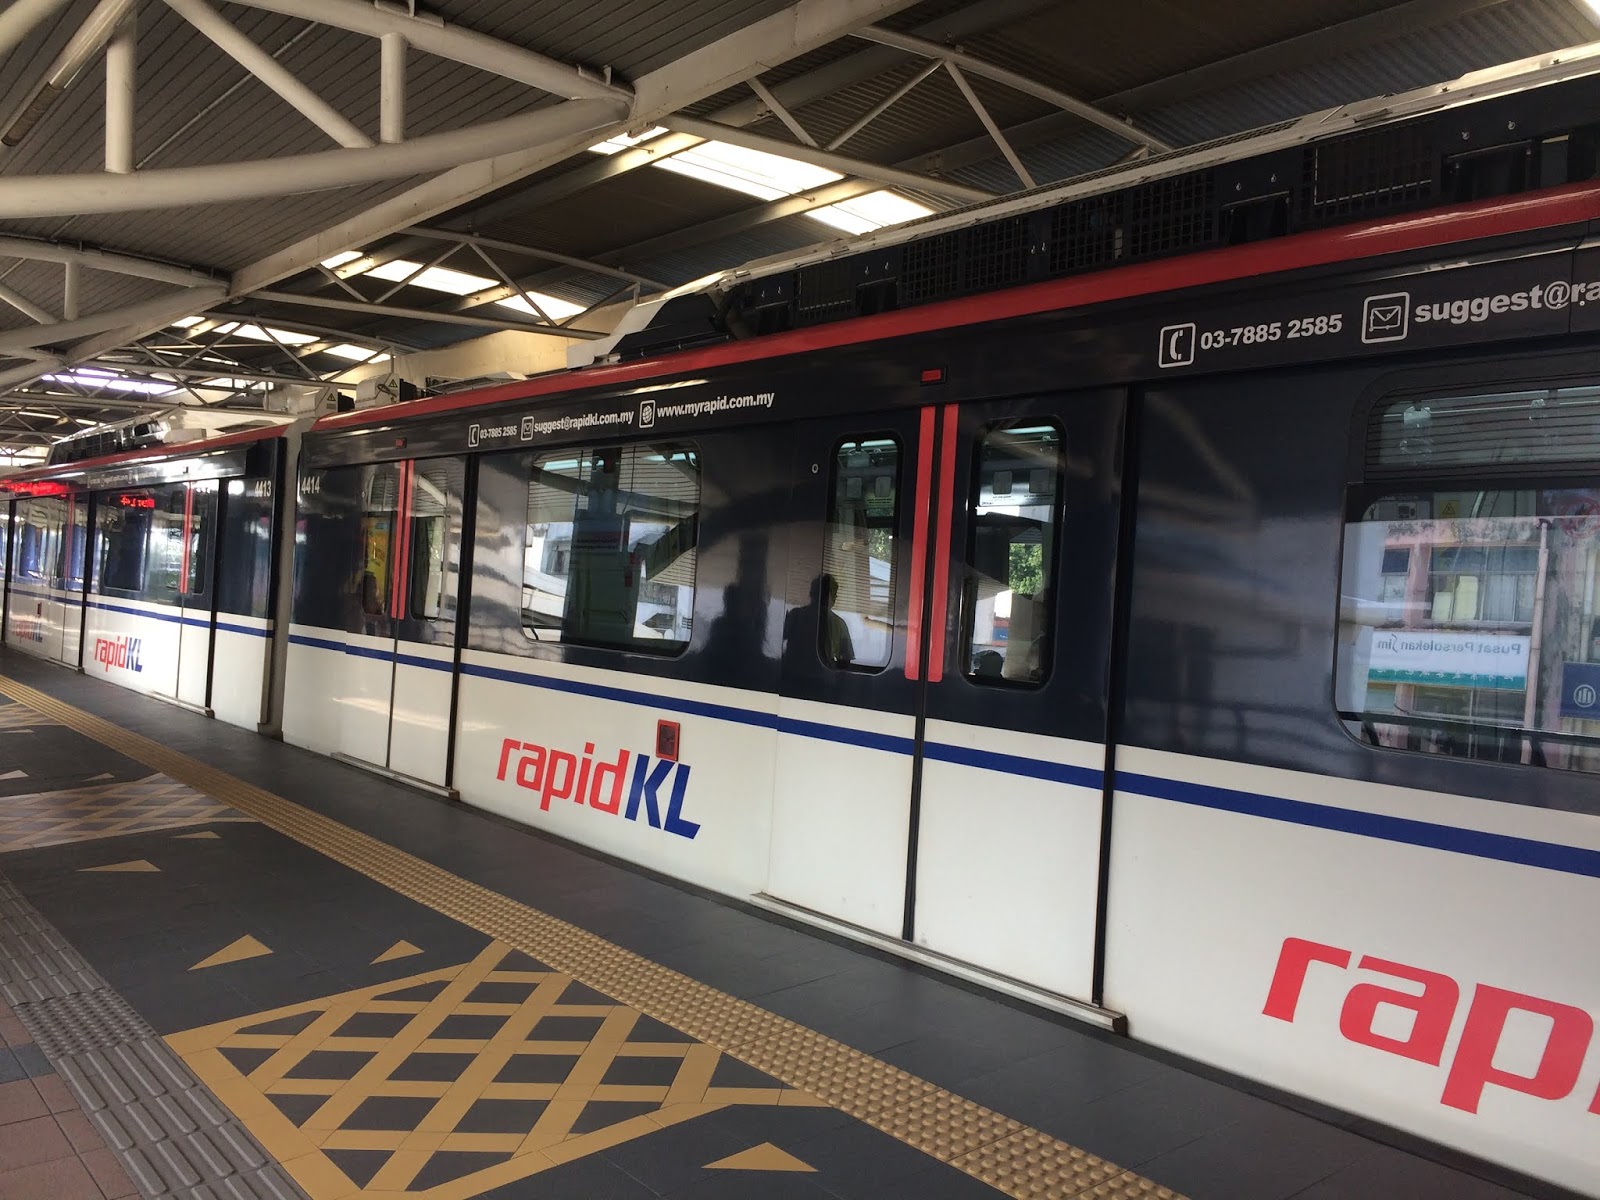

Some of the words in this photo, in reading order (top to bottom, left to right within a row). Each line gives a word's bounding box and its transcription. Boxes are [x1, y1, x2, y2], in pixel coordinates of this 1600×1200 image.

[1200, 322, 1282, 350] 03-7885
[1286, 314, 1343, 339] 2585
[1414, 280, 1600, 325] suggest@ra
[479, 426, 502, 440] 03-7885
[502, 425, 518, 437] 2585
[533, 410, 635, 434] suggest@rapidkl.com.my
[656, 392, 775, 417] www.myrapid.com.my
[254, 480, 272, 498] 4413
[301, 475, 321, 494] 4414
[94, 635, 143, 673] rapidKL
[496, 738, 701, 840] rapidKL
[1261, 936, 1600, 1115] rap
